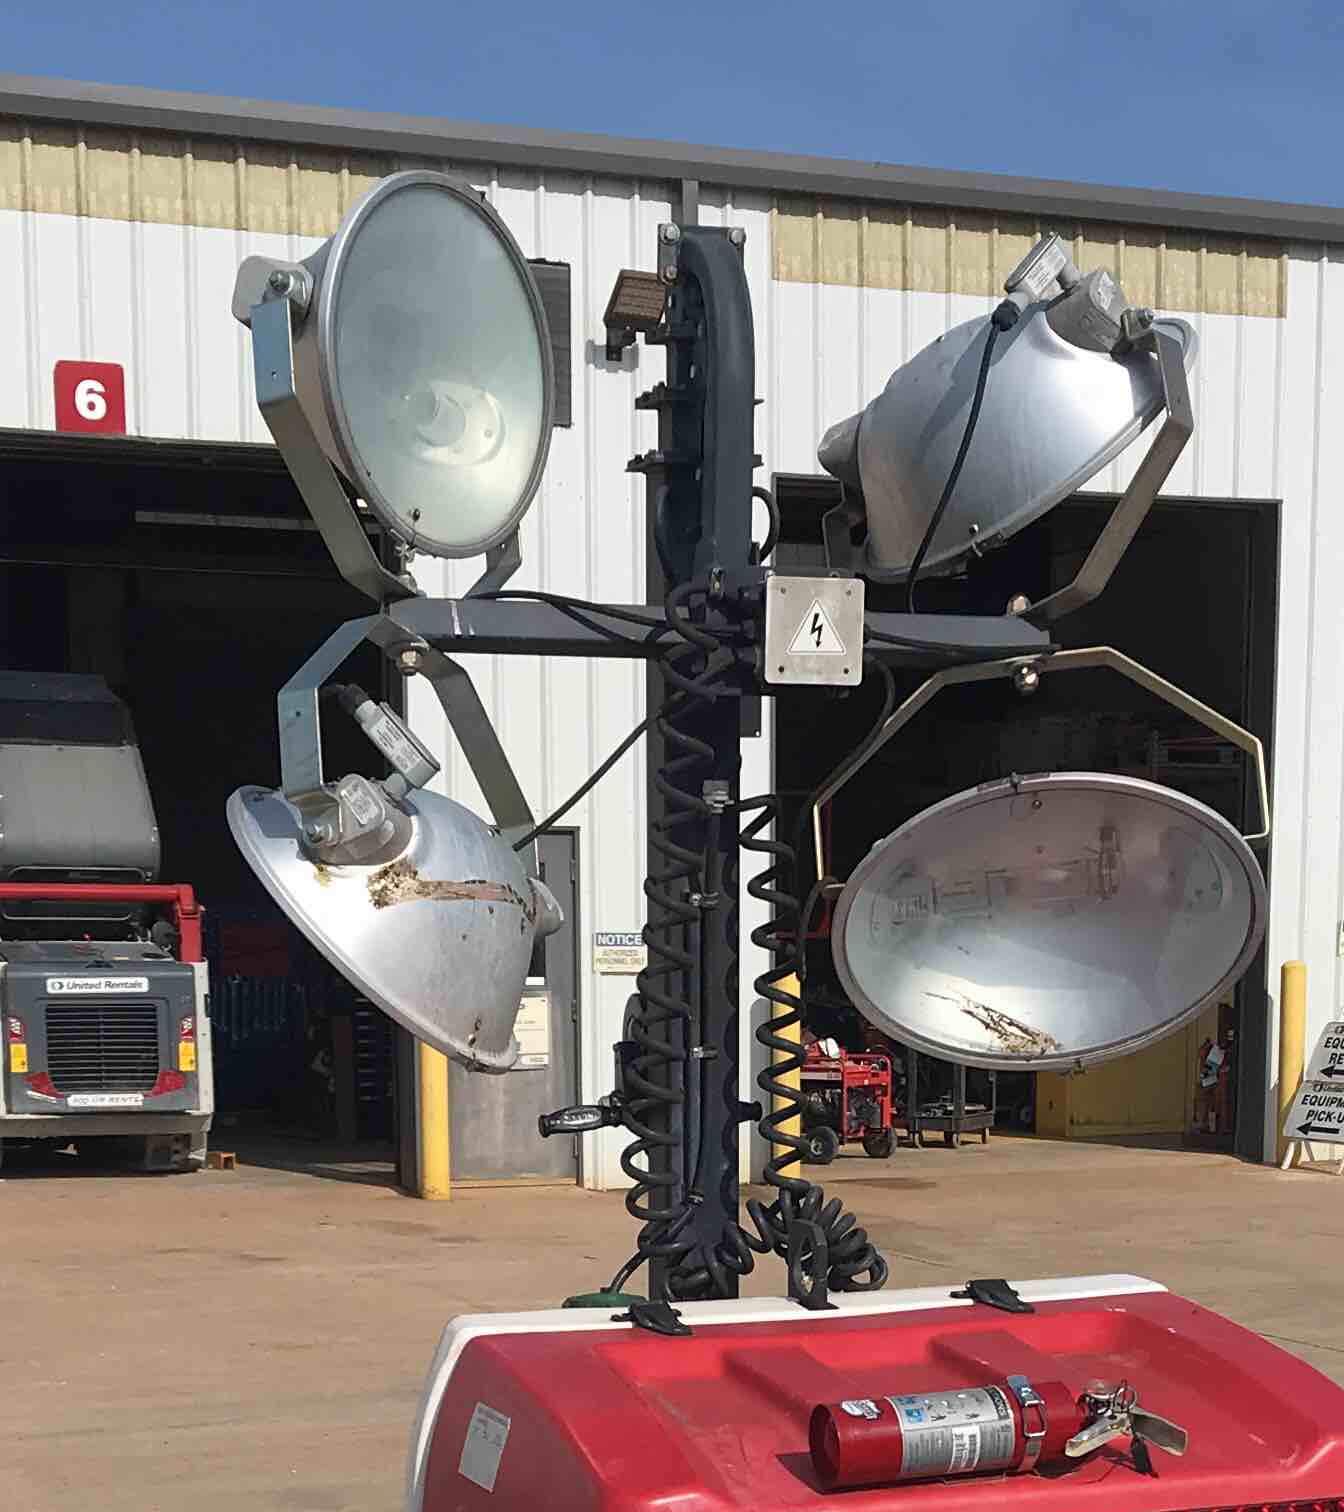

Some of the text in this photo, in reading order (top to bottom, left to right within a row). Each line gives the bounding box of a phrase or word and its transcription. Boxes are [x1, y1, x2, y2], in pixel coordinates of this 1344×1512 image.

[74, 378, 107, 421] 6
[597, 934, 642, 946] NOTICE
[66, 977, 143, 990] United Rentals
